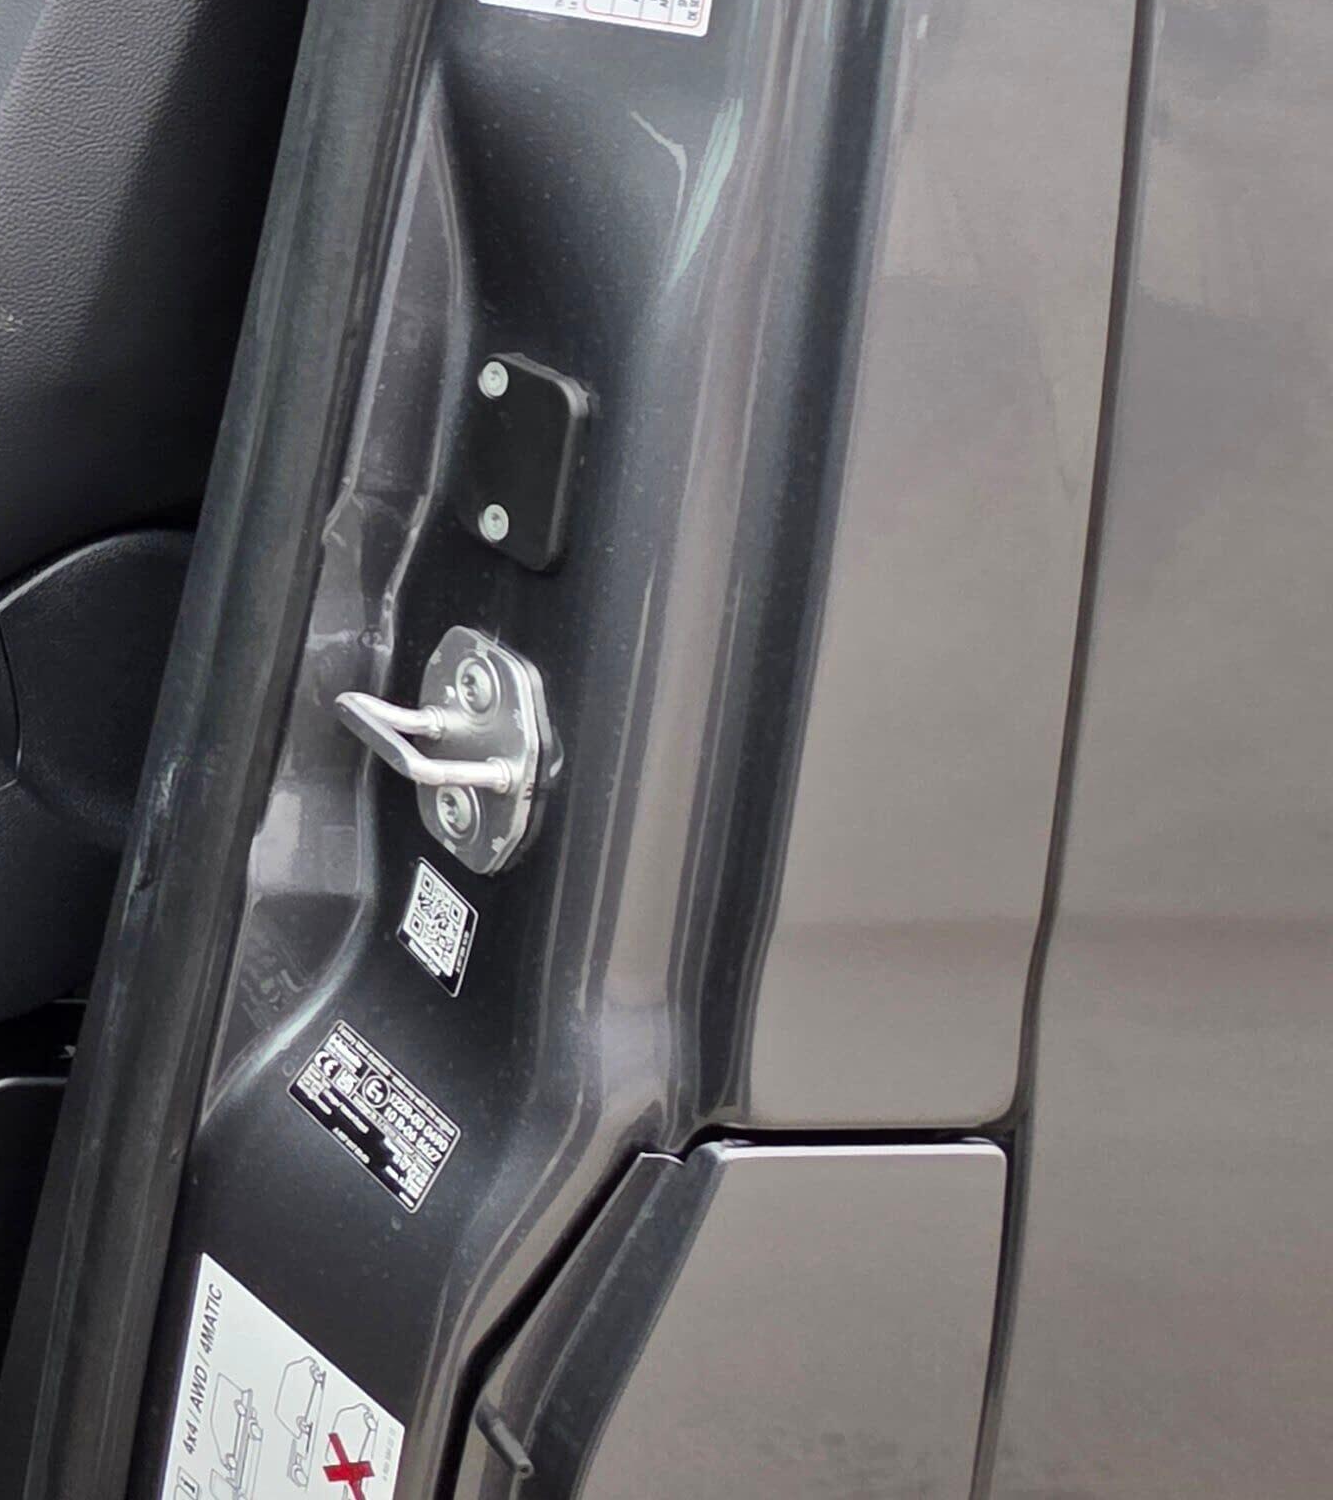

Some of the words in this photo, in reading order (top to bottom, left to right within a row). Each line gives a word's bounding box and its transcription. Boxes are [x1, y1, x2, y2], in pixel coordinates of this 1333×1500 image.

[314, 1051, 339, 1076] CE
[183, 1420, 197, 1455] 4x4
[191, 1365, 208, 1411] AWD
[200, 1283, 223, 1354] 4MATIC
